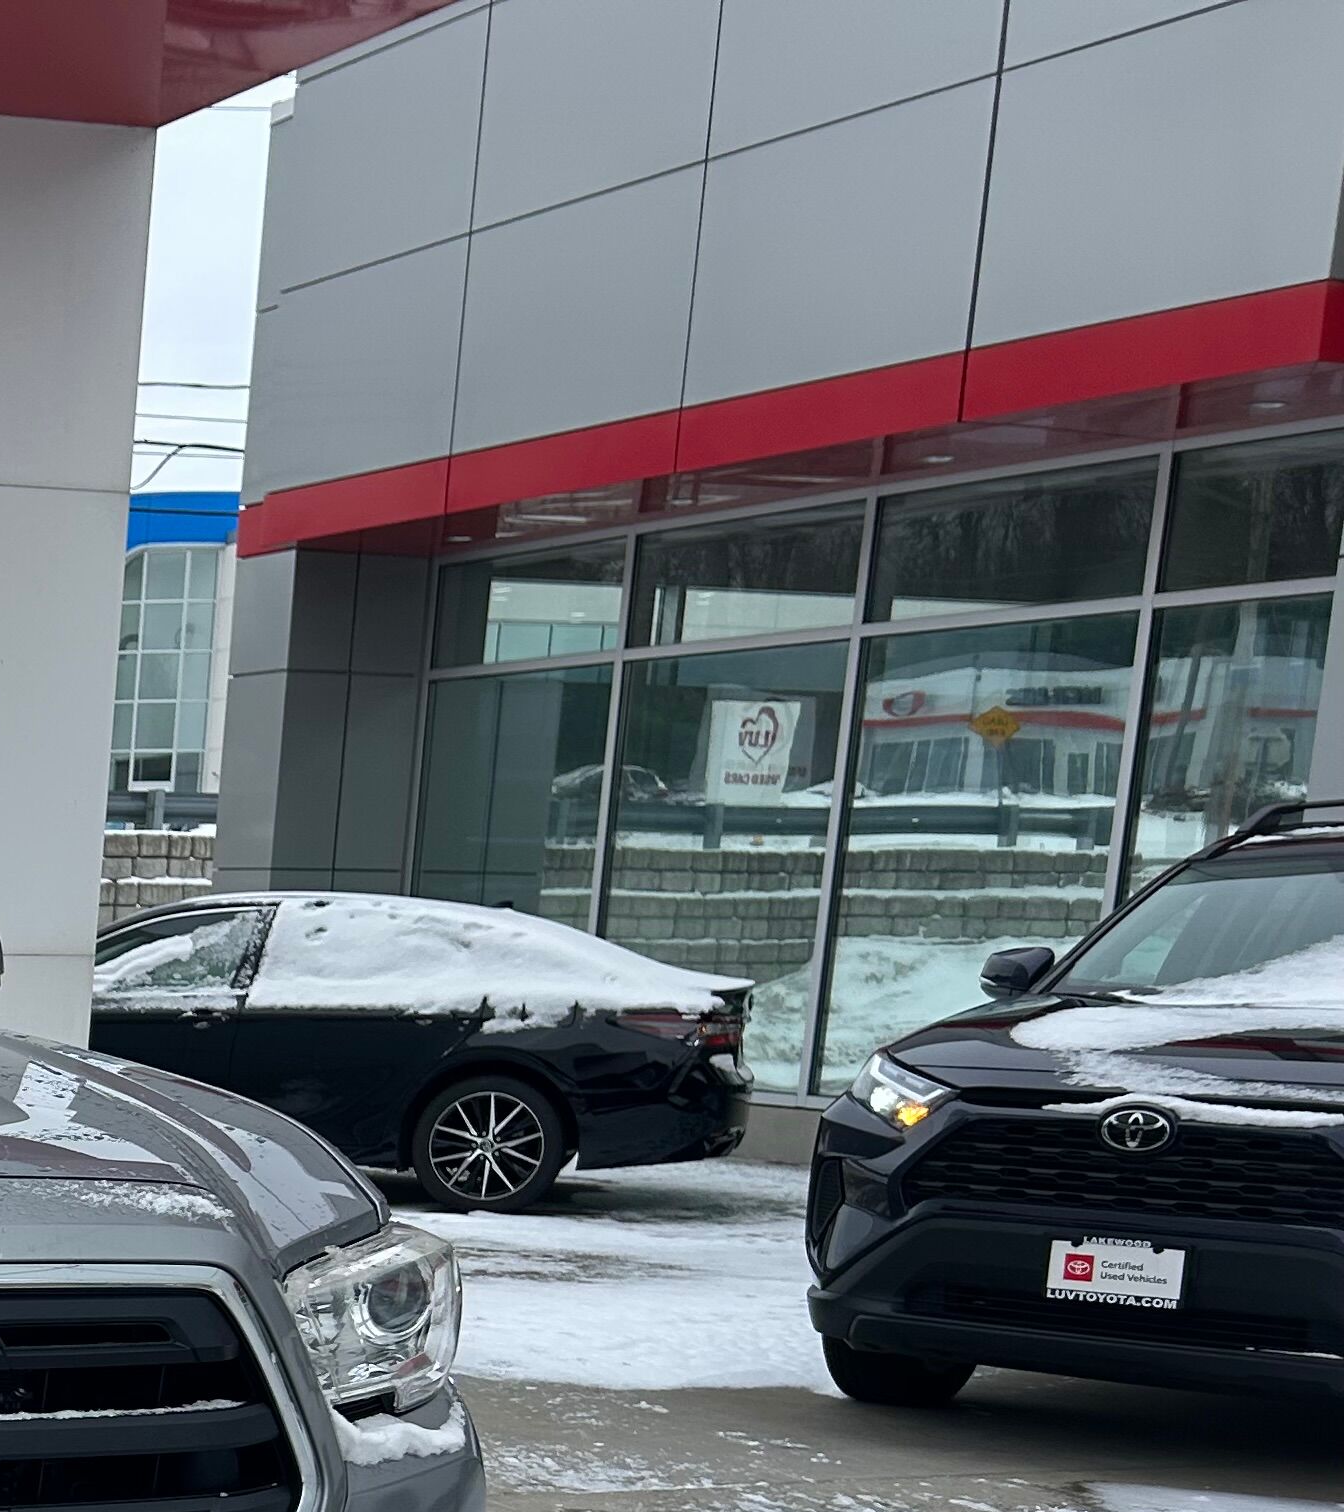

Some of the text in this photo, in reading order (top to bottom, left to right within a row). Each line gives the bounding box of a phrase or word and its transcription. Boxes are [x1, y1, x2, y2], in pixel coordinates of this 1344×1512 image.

[1082, 1236, 1152, 1248] LAKEWOOD
[1101, 1260, 1144, 1272] Certified
[1100, 1272, 1168, 1285] Used Vehicles
[1046, 1288, 1178, 1310] LUVTOYOTA.COM
